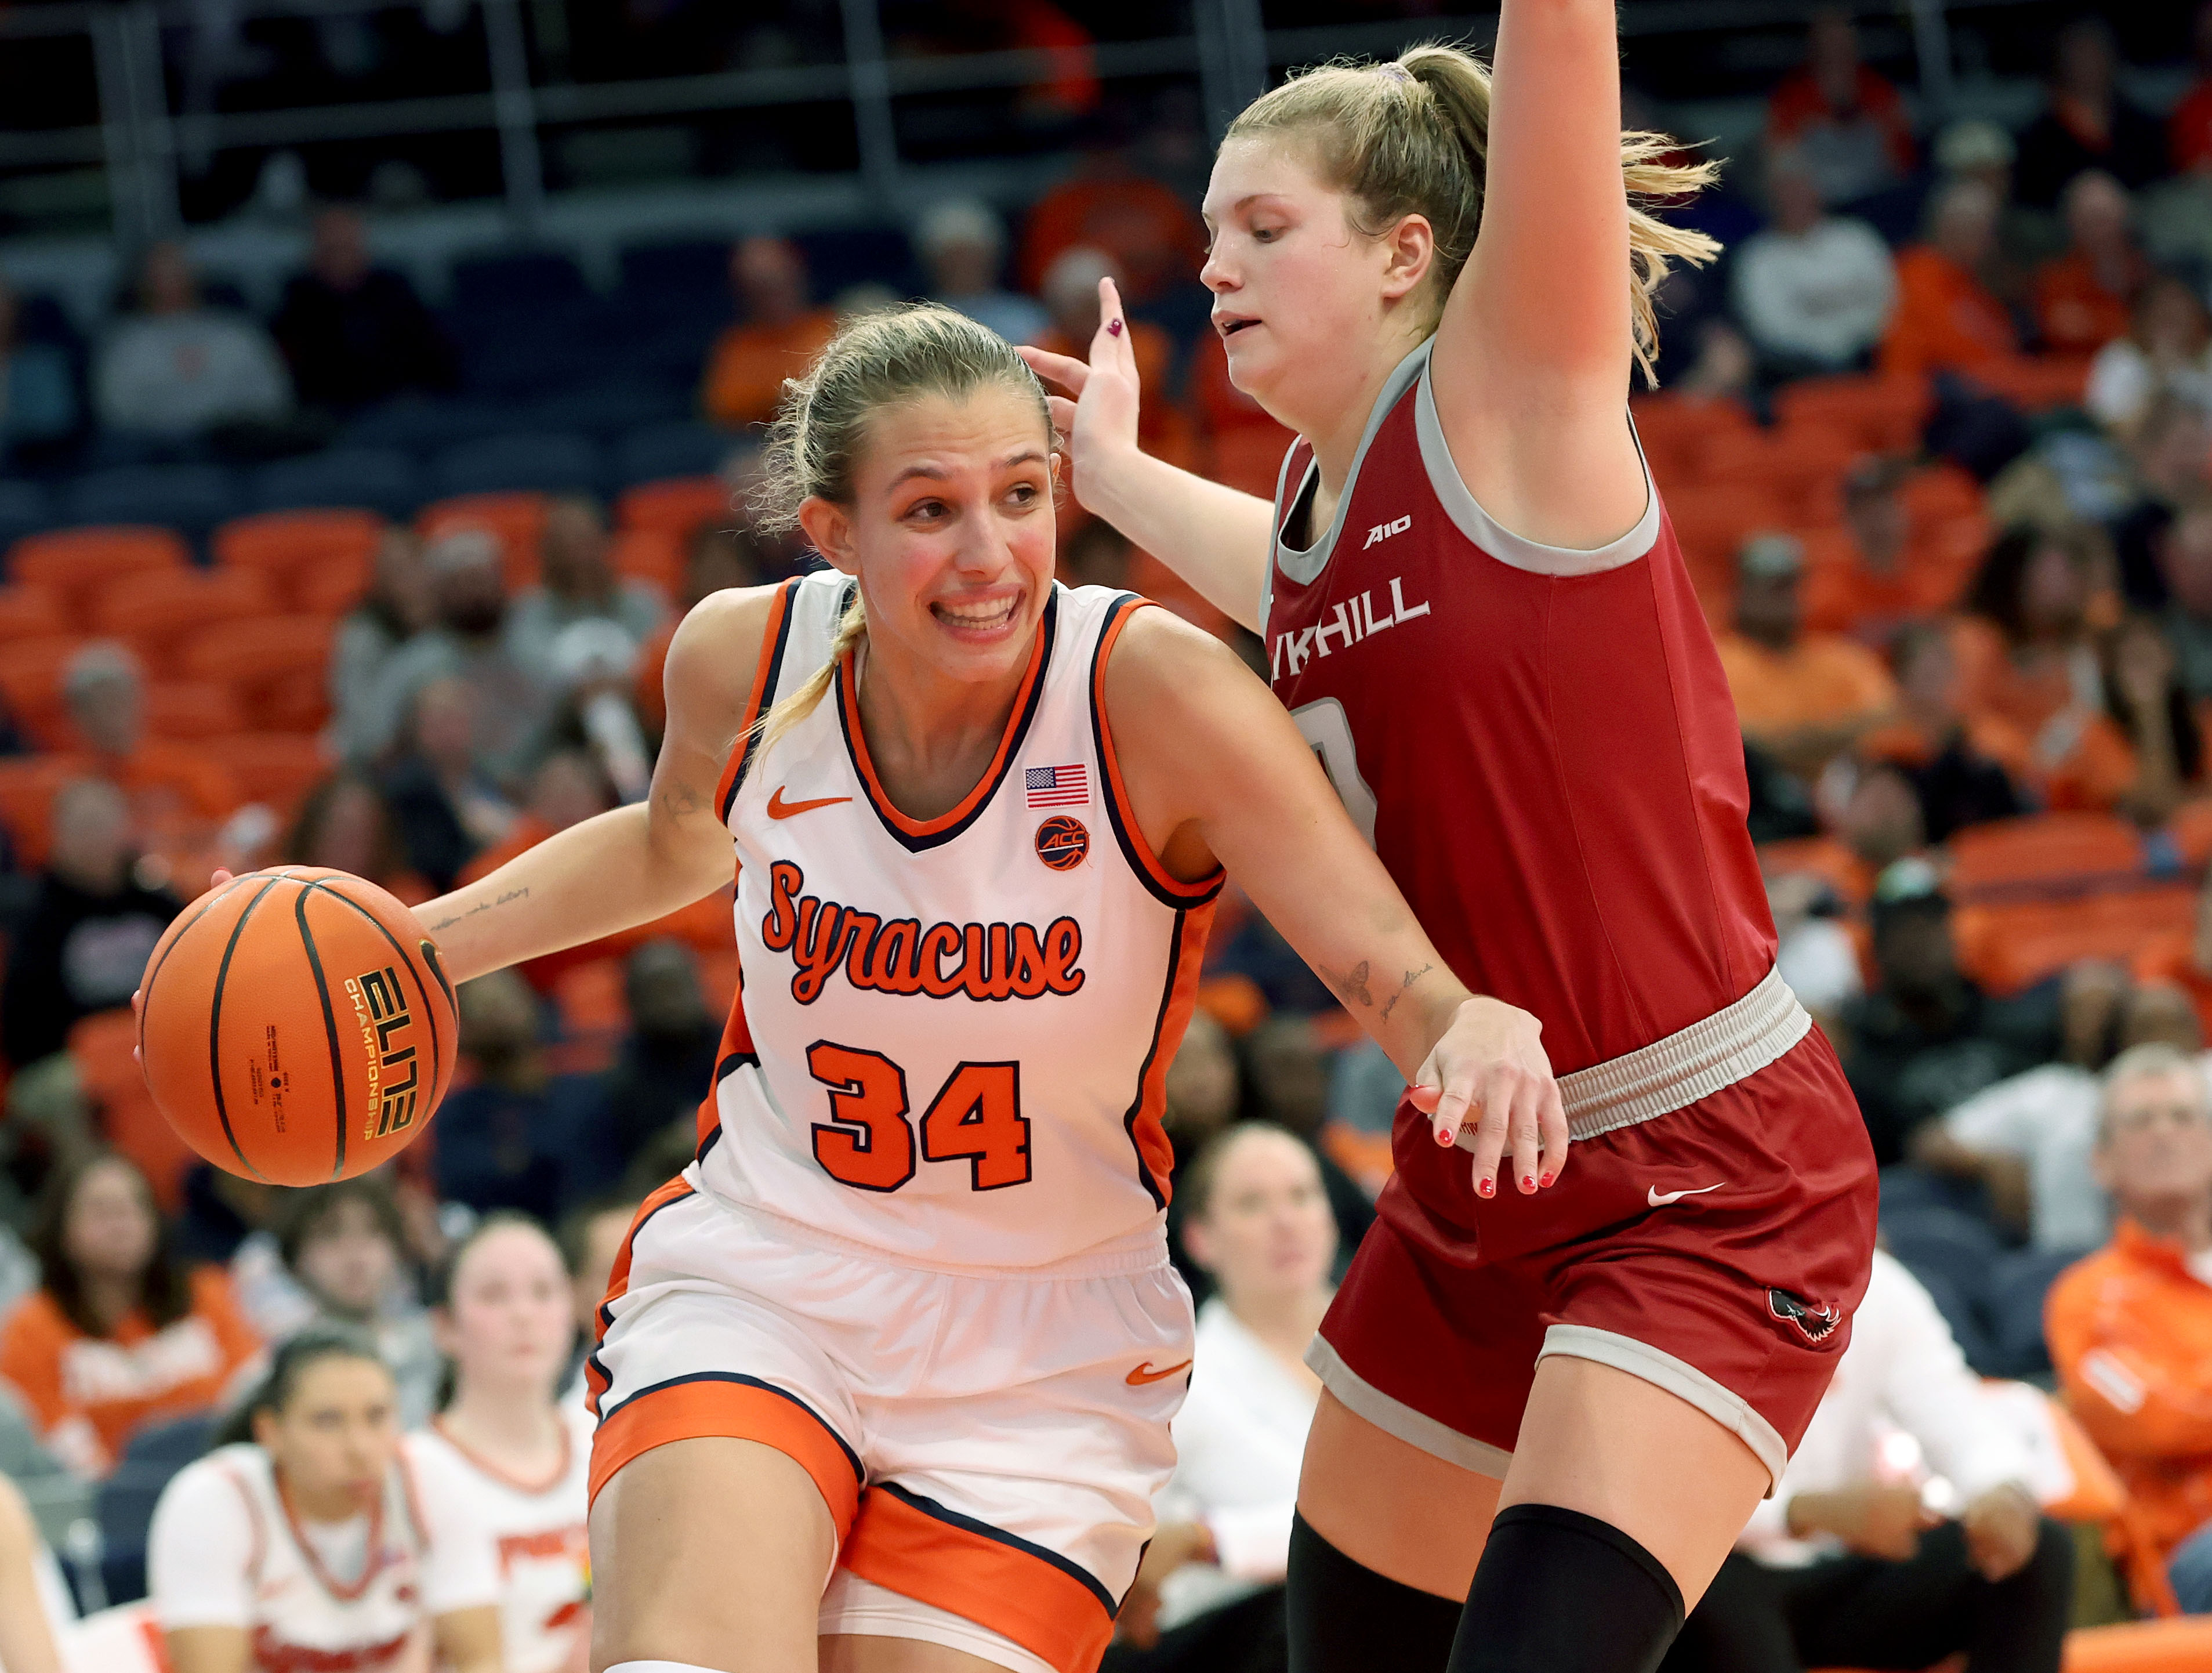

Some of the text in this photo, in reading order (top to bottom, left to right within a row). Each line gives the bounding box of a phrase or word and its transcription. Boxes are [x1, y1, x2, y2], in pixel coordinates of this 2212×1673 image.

[1042, 830, 1086, 849] ACC
[761, 859, 1086, 1005] Syracuse
[344, 977, 380, 1141] CHAMPIONSHIP
[357, 966, 419, 1139] ELITE
[805, 1038, 1032, 1193] 34
